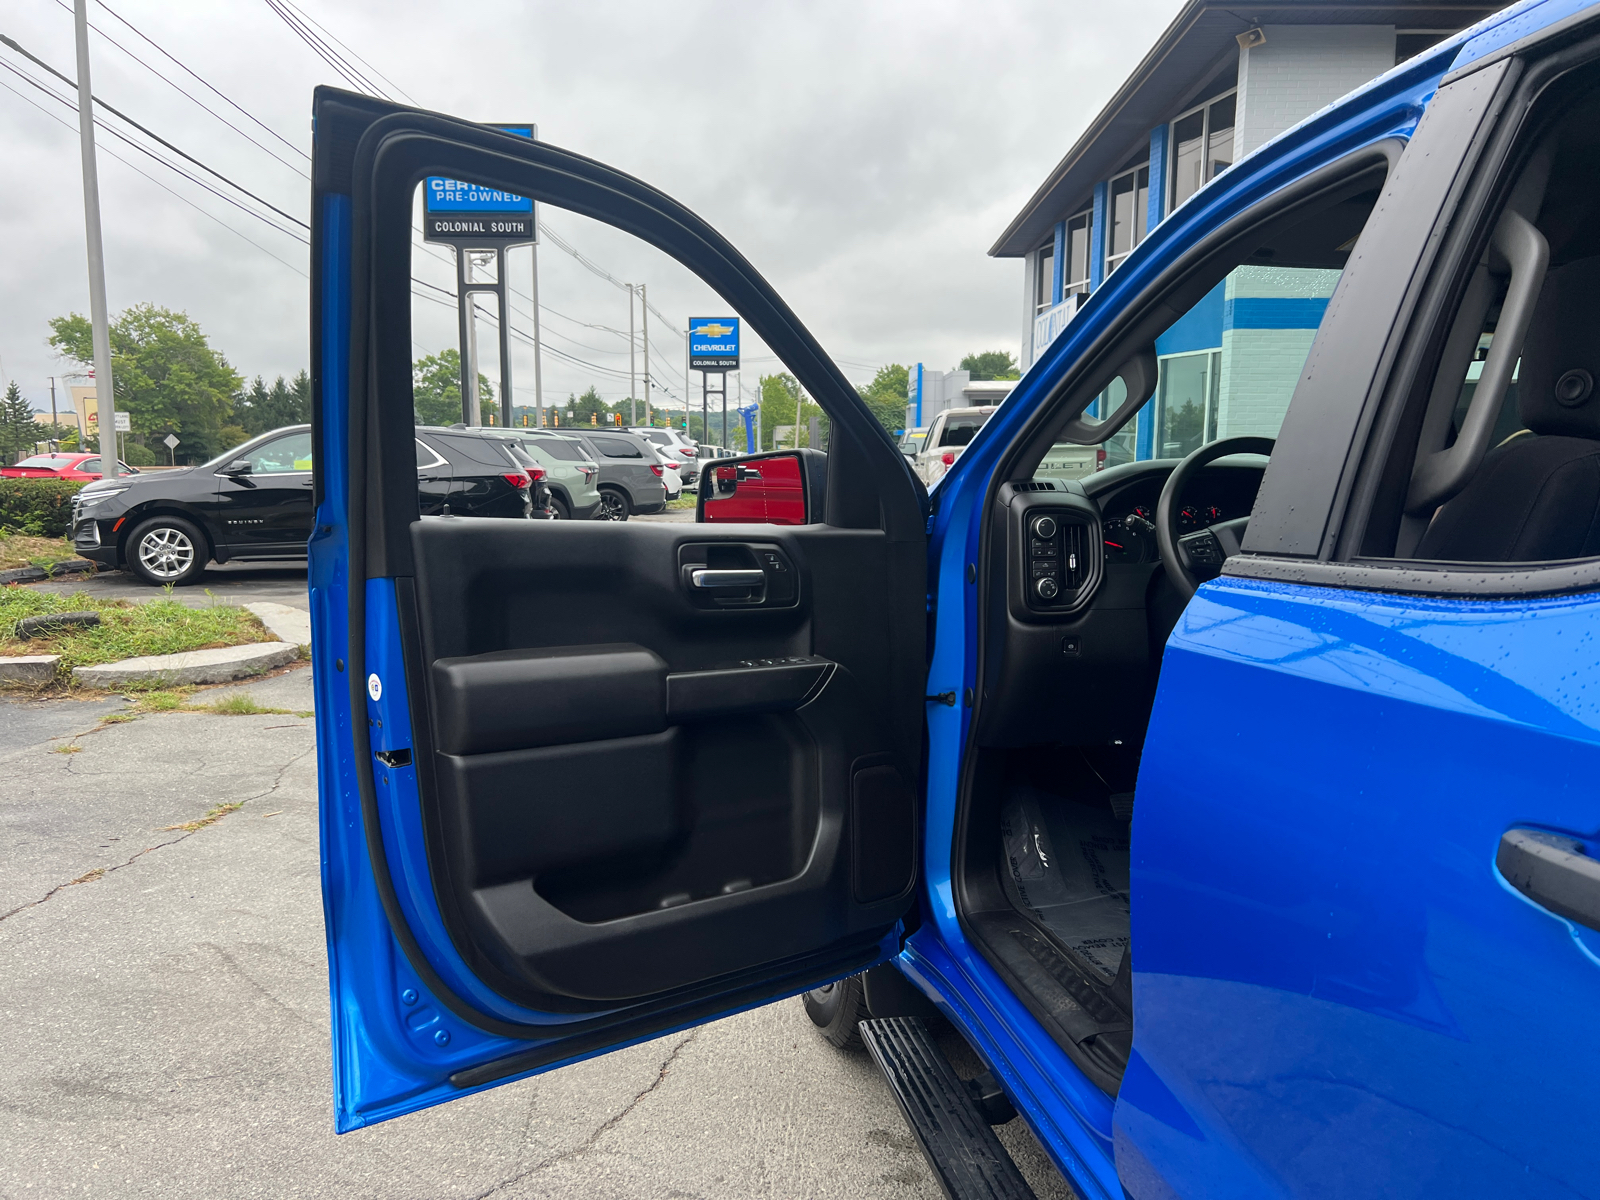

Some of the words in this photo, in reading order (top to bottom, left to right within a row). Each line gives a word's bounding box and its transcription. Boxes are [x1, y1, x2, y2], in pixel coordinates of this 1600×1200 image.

[435, 222, 486, 232] COLONIAL
[491, 222, 525, 232] SOUTH
[1038, 462, 1087, 470] OLET
